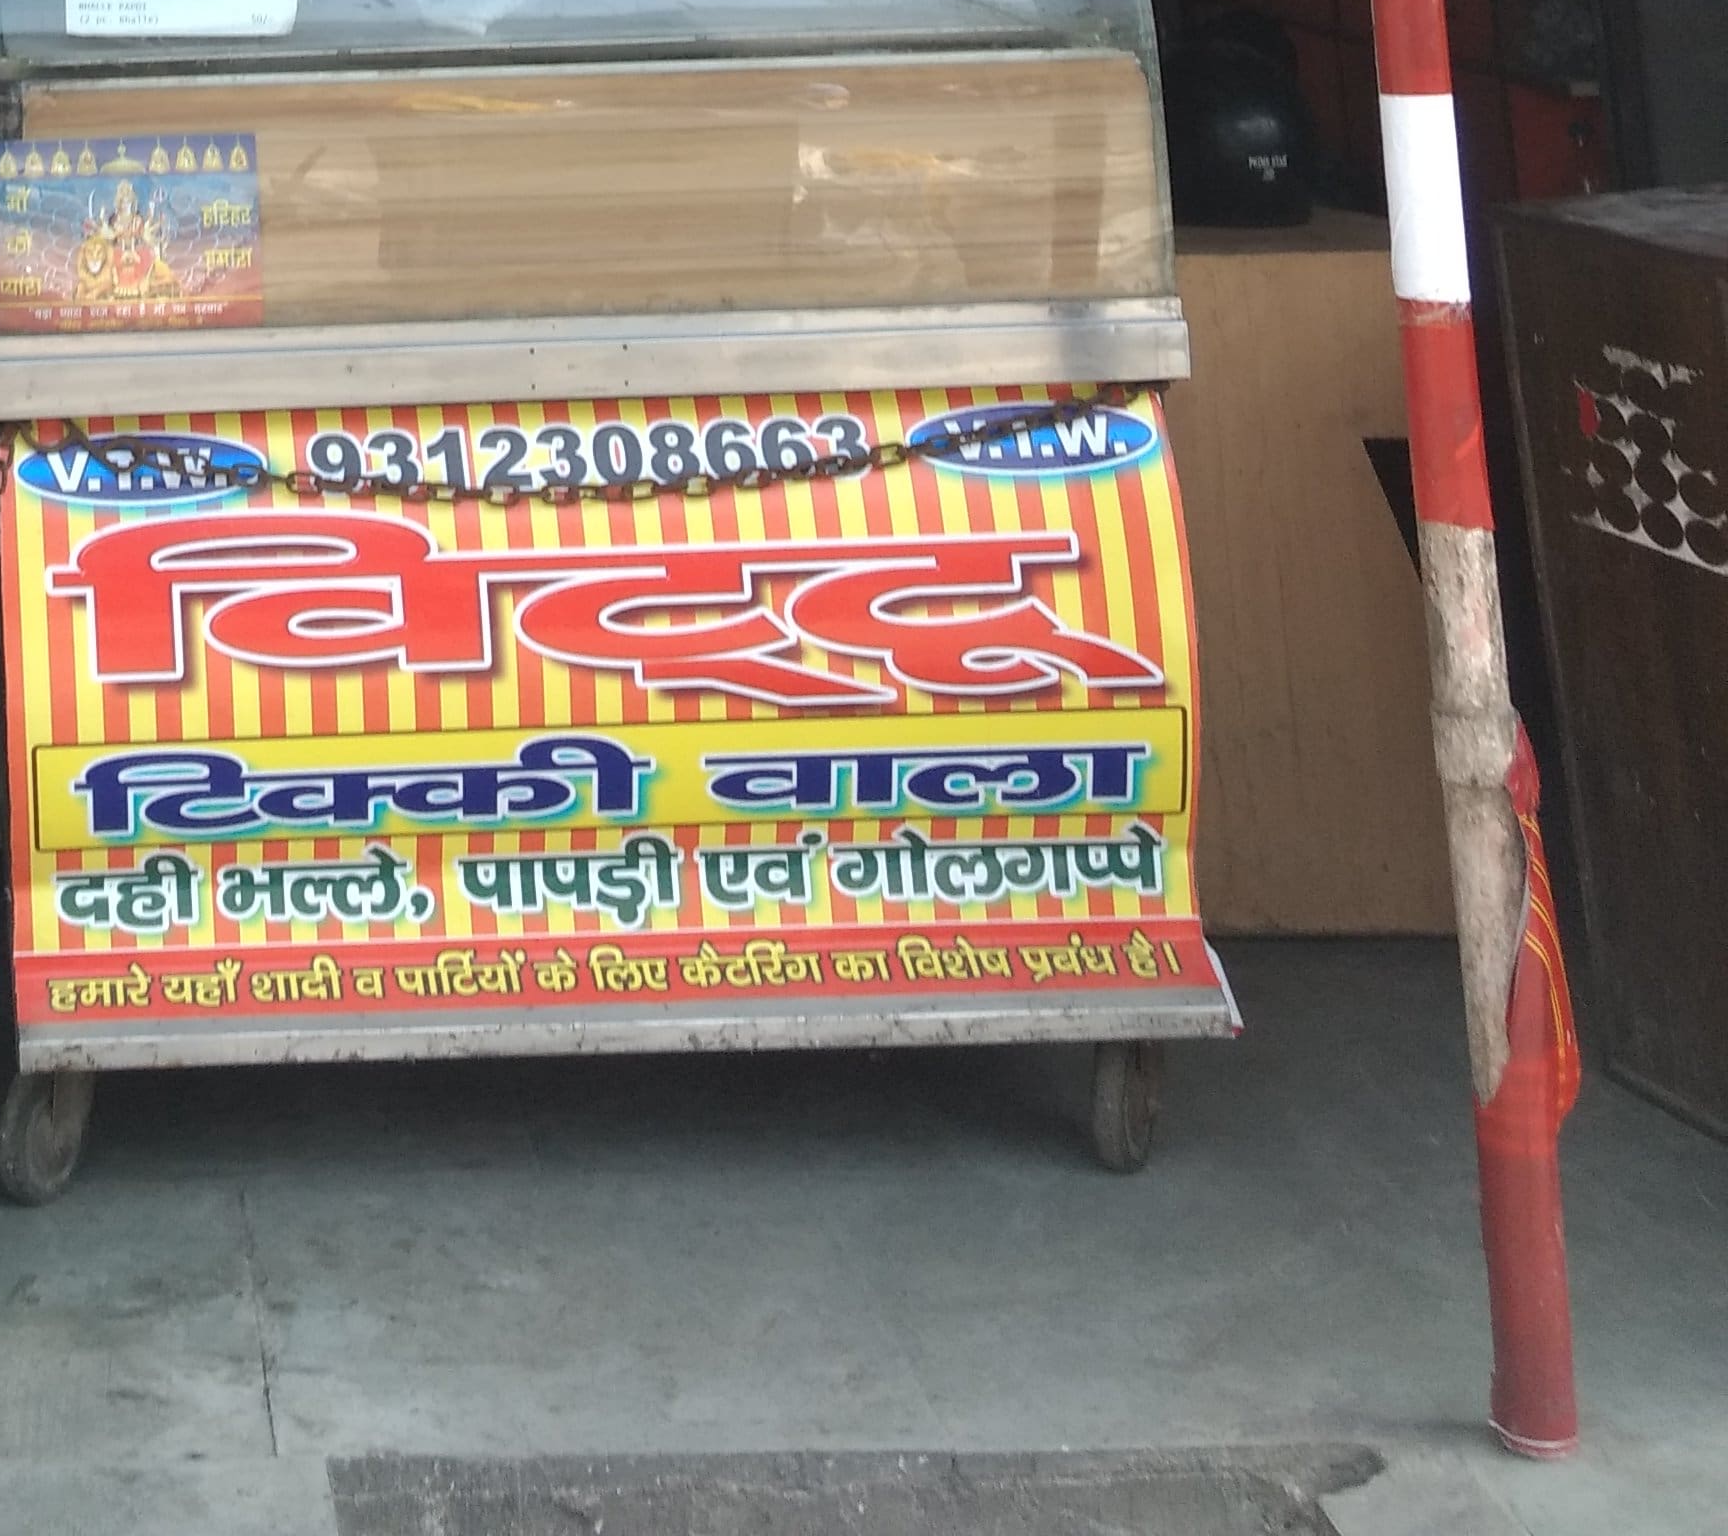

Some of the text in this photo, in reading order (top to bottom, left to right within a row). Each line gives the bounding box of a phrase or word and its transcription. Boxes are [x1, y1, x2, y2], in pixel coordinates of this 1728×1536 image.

[308, 416, 868, 494] 9312308663
[73, 738, 1150, 834] टिक्की वाला
[56, 826, 1164, 928] दही भल्ले, पापड़ी एवं गोलगप्पे
[49, 964, 152, 1012] हमारे
[250, 954, 343, 1001] शादी
[352, 968, 384, 998] व
[533, 947, 577, 992] के
[589, 944, 668, 992] लिए
[832, 953, 890, 984] का
[897, 934, 1012, 982] विशेष
